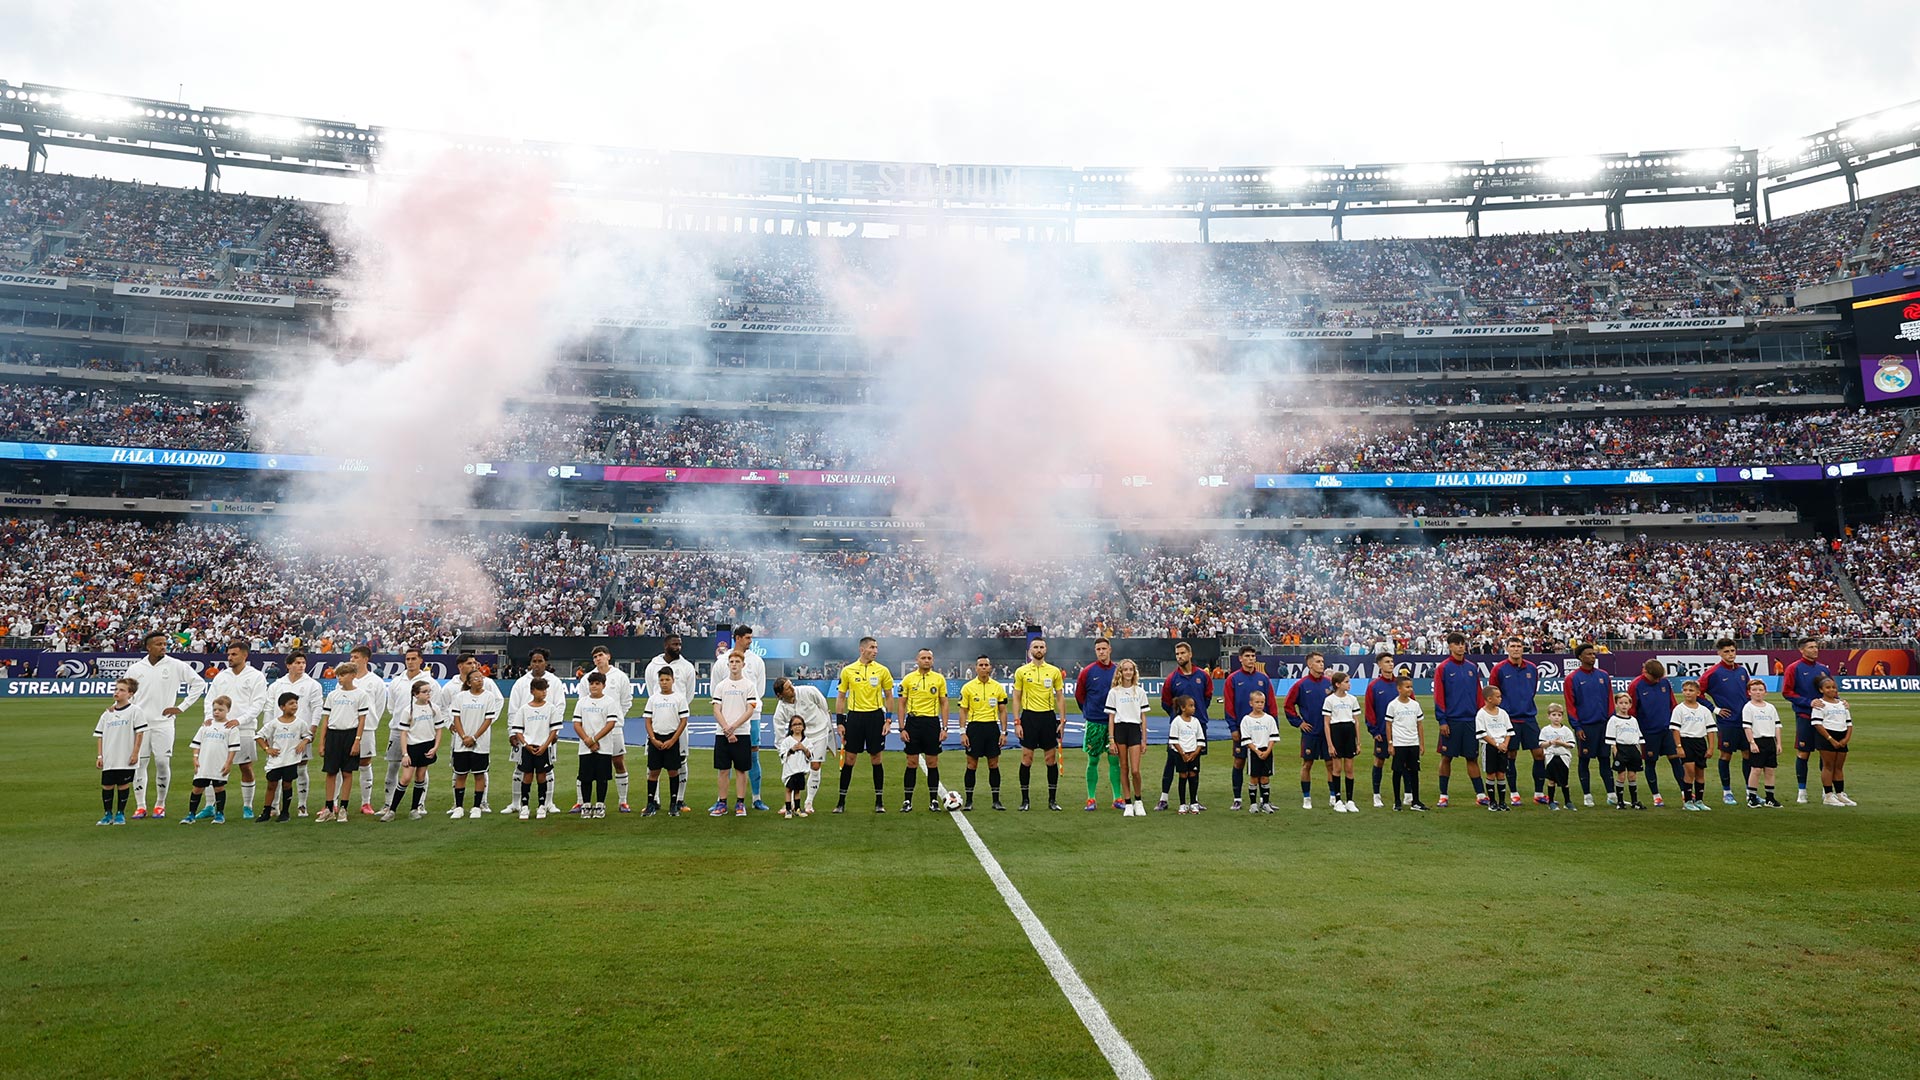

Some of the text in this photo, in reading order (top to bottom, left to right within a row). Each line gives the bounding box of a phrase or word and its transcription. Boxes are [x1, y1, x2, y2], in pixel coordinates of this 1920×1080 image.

[878, 164, 1021, 198] STADIUM
[0, 274, 57, 286] OOZER
[129, 286, 280, 304] 80 WAYNE CHREBET
[741, 323, 781, 331] LARRY
[1606, 319, 1727, 330] 74 NICK MANGOLD
[1282, 330, 1305, 338] JOE
[1416, 326, 1540, 336] 93 MARTY LYONS
[111, 449, 226, 466] HALA MADRID
[821, 474, 897, 486] VISCA EL BARÇA
[1435, 473, 1528, 486] HALA MADRID
[224, 503, 256, 513] MetLife
[812, 520, 926, 528] METLIFE STADIUM
[1424, 519, 1450, 527] MetLife
[1579, 517, 1612, 526] verizon
[1697, 514, 1739, 523] HCLTech
[799, 641, 810, 657] 0
[8, 681, 117, 695] STREAM DIRE
[1841, 678, 1898, 690] STREAM
